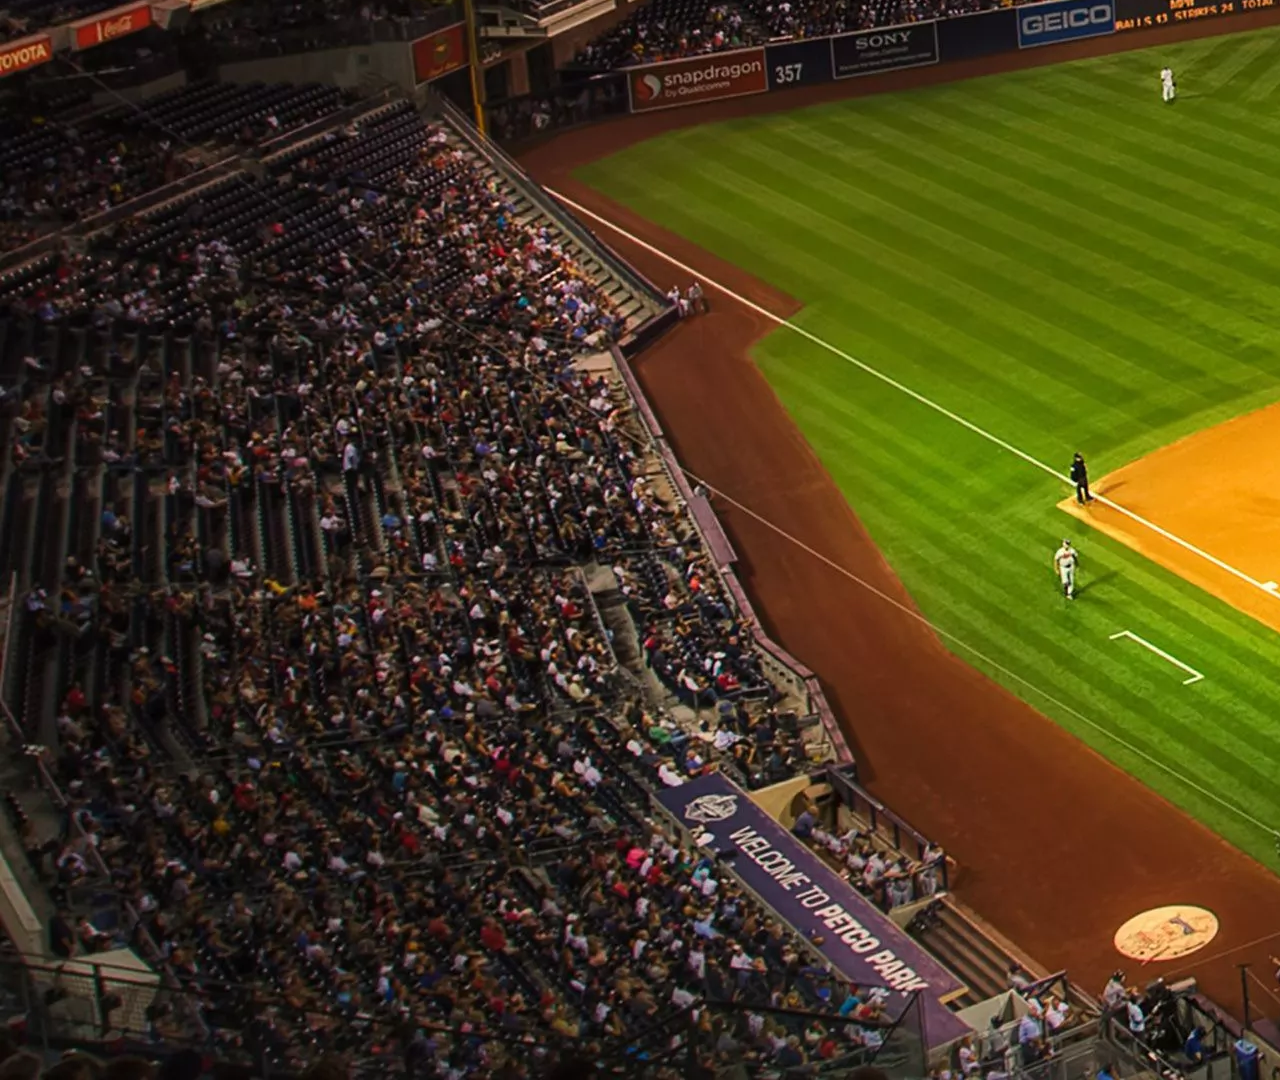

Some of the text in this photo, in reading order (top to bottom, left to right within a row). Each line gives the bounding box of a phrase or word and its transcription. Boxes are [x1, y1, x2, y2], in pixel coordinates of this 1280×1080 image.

[1022, 4, 1112, 36] GEICO
[1174, 5, 1218, 20] STRIKES
[855, 30, 912, 50] SONY
[664, 60, 762, 88] snapdragon
[775, 63, 803, 84] 357
[729, 825, 929, 997] WELCOME TO PETCO PARK
